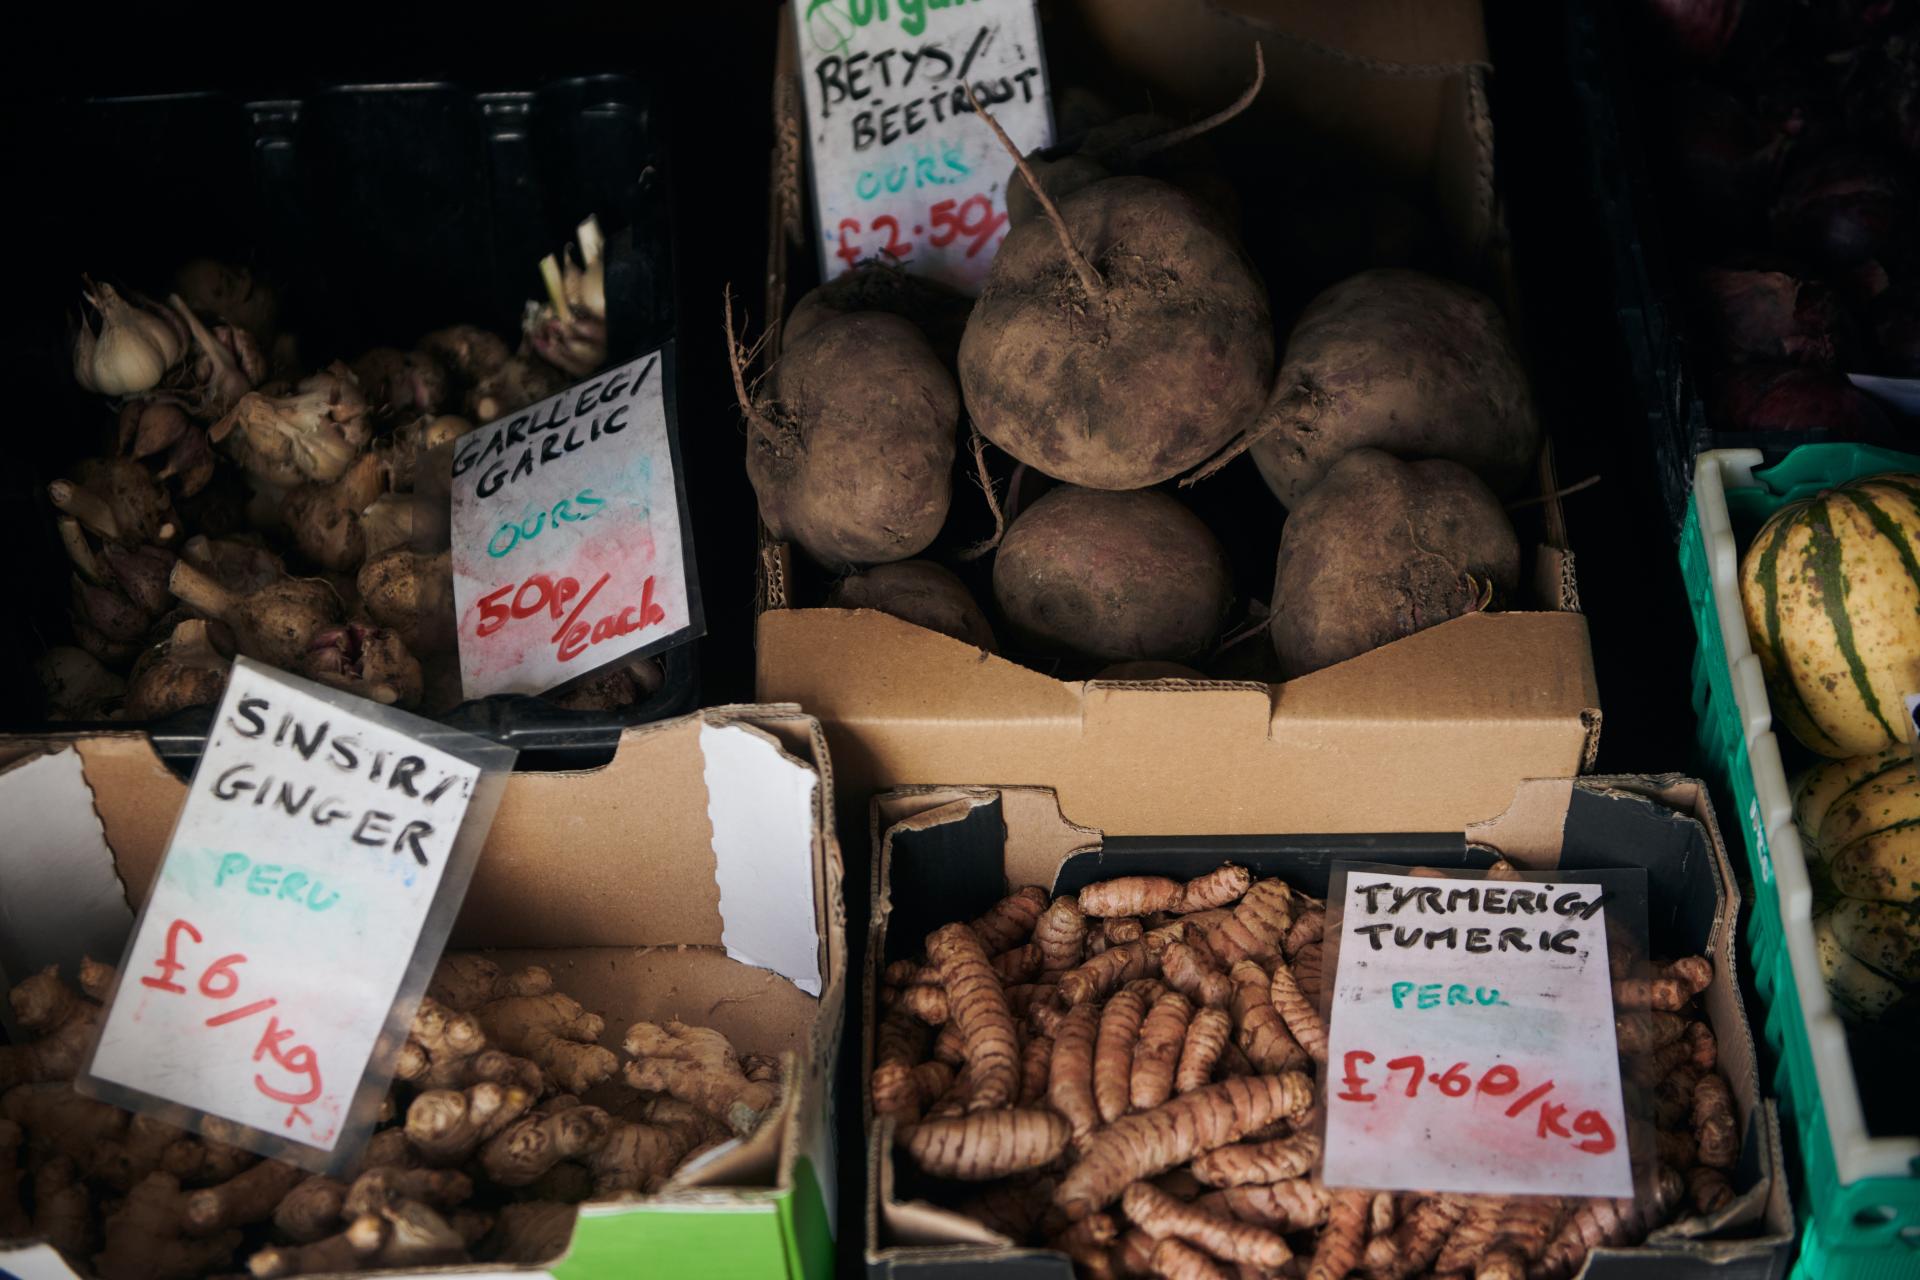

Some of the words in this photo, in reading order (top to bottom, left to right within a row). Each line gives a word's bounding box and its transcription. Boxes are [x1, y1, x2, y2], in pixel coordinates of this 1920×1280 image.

[814, 26, 988, 118] BETYS/
[851, 67, 1038, 151] BEETROUT
[857, 151, 971, 200] OURS
[836, 192, 1008, 268] £2.50/
[452, 356, 657, 478] GARLLEG/
[476, 404, 630, 498] GARLIC
[487, 489, 606, 558] OURS
[229, 697, 457, 805] SINSIR/
[212, 763, 436, 867] GINGER
[214, 852, 341, 912] PERU
[1354, 923, 1580, 954] TUMERIC
[1391, 981, 1502, 1009] PERU
